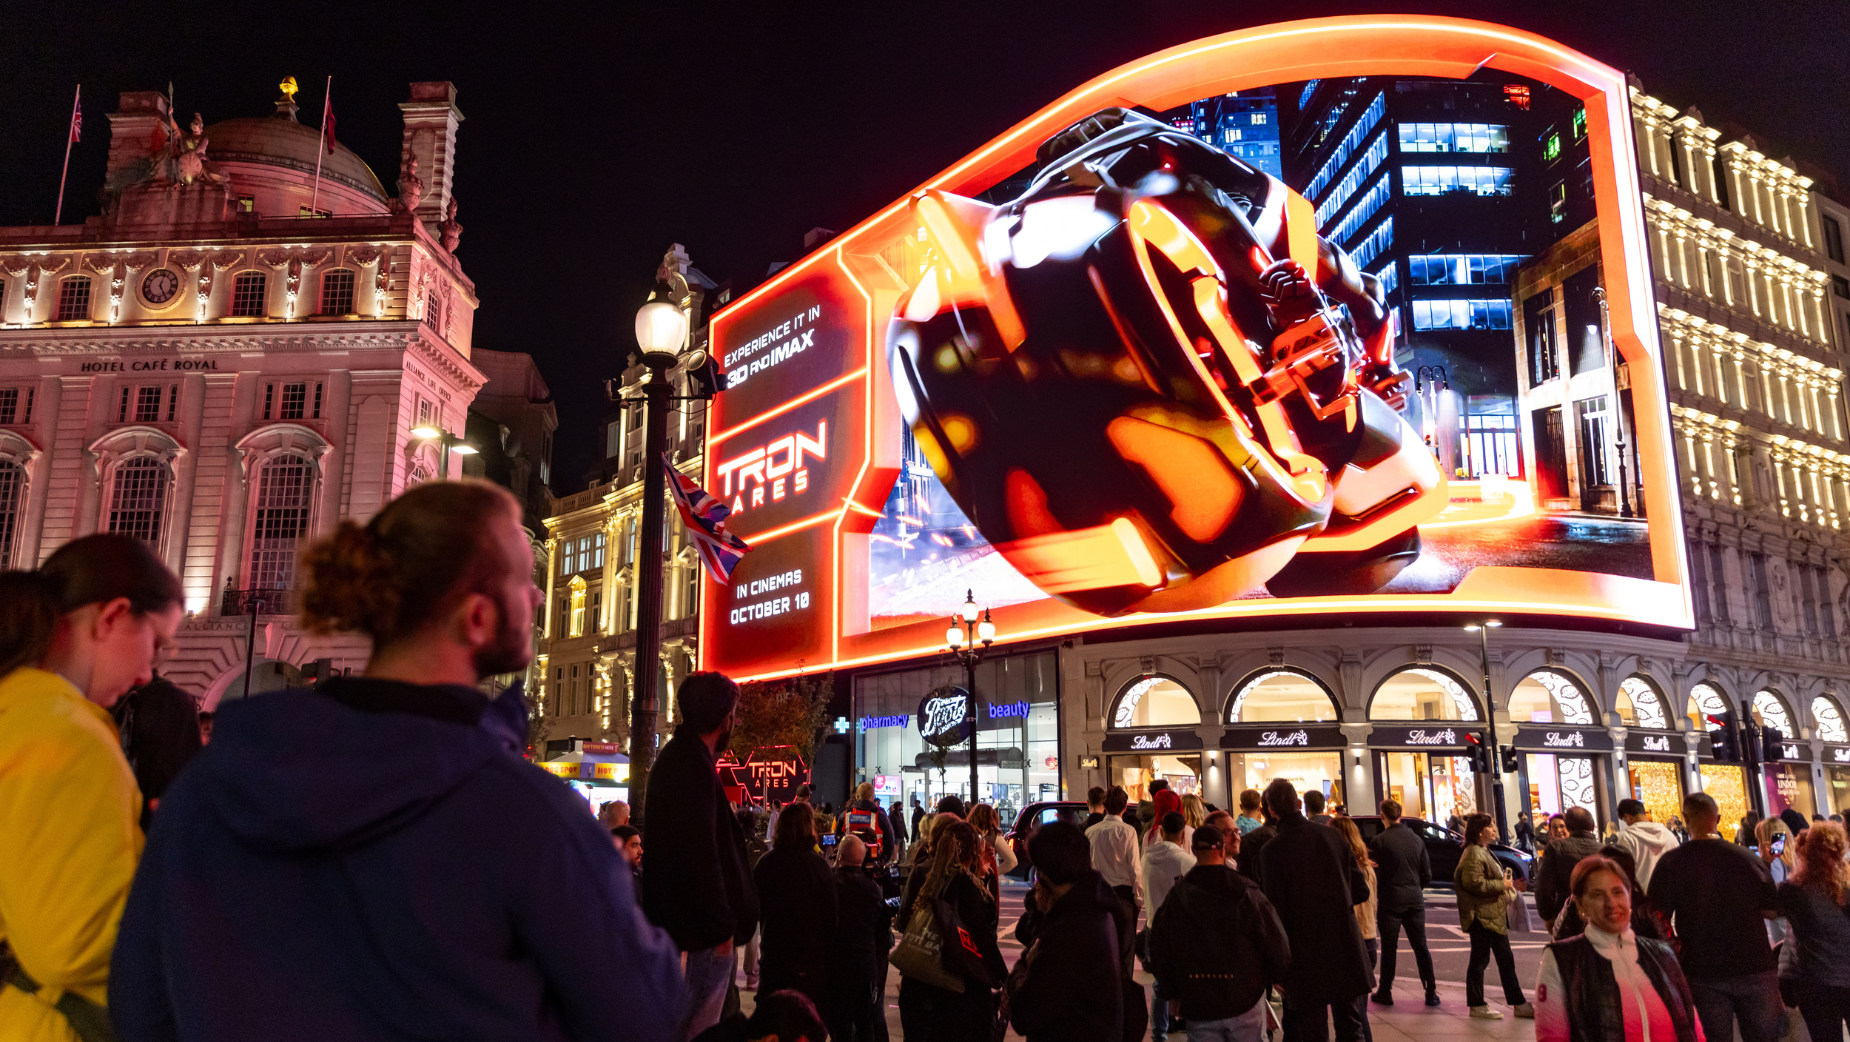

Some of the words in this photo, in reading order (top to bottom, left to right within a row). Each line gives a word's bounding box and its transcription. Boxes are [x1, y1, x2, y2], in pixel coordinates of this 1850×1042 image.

[724, 320, 791, 368] EXPERIENCE
[794, 312, 805, 330] IT
[808, 304, 821, 322] IN
[81, 362, 126, 372] HOTEL
[132, 359, 168, 371] CAFÉ
[174, 360, 218, 370] ROYAL
[726, 364, 749, 389] 3D
[750, 354, 770, 376] AND
[770, 328, 815, 367] IMAX
[406, 361, 425, 382] ALLIANCE
[428, 378, 437, 391] LIFE
[439, 387, 452, 402] OFFICE
[717, 421, 826, 497] TRON
[732, 469, 808, 515] ARES
[736, 583, 748, 599] IN
[750, 569, 802, 596] CINEMAS
[730, 596, 790, 625] OCTOBER
[794, 592, 810, 609] 10
[184, 622, 249, 631] ALLIANCE
[921, 695, 967, 737] Boots
[989, 700, 1030, 719] beauty
[861, 714, 909, 732] pharmacy
[1130, 735, 1163, 749] Lindt
[1257, 731, 1299, 746] Lindt
[1405, 730, 1445, 745] Lindt
[1543, 732, 1577, 747] Lindt
[560, 766, 577, 774] SPOT
[749, 760, 797, 778] TRON
[755, 779, 789, 788] ARES
[1538, 983, 1547, 1003] 9
